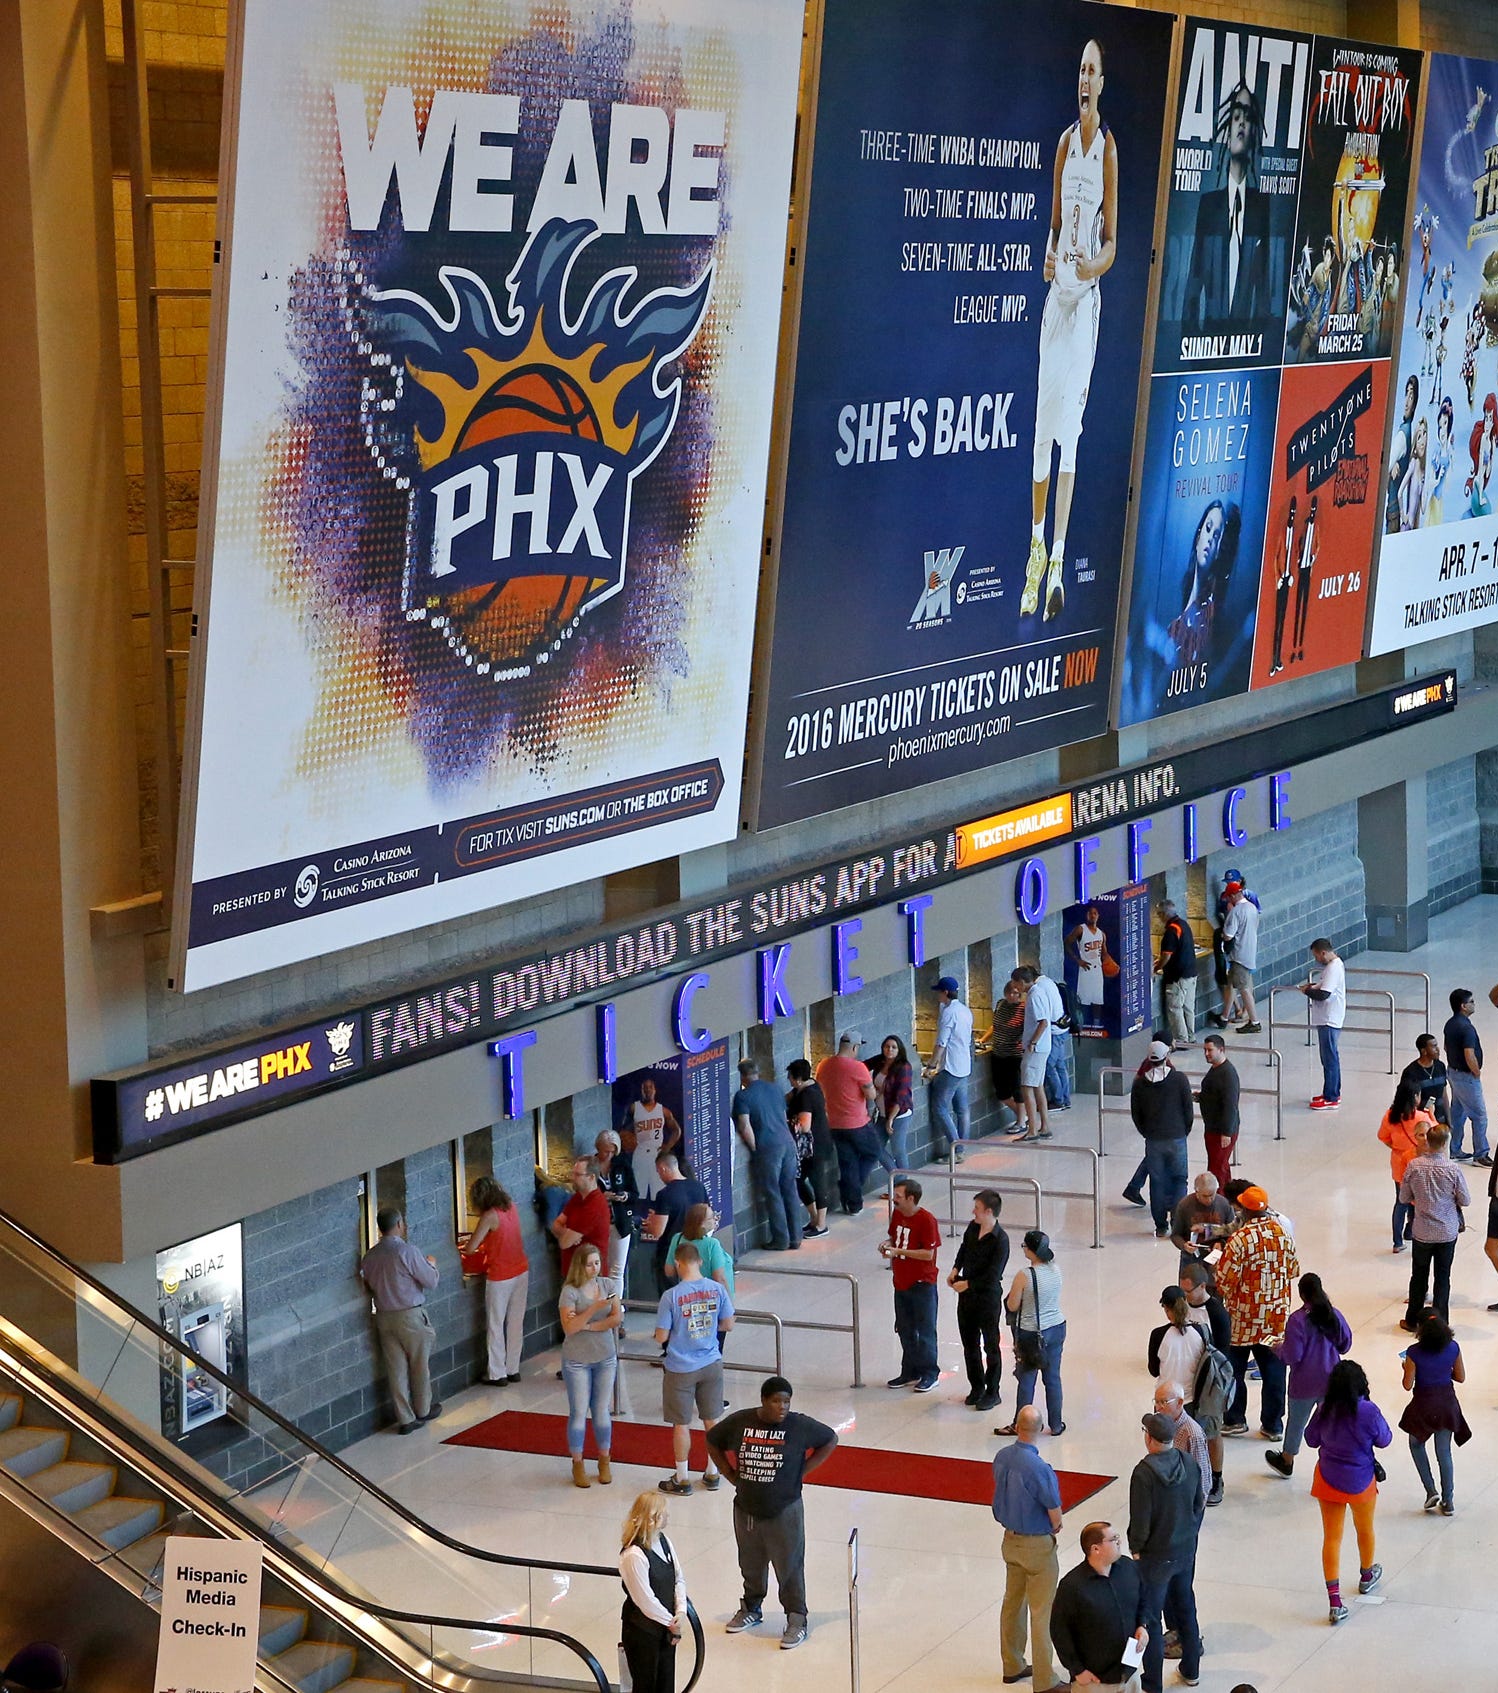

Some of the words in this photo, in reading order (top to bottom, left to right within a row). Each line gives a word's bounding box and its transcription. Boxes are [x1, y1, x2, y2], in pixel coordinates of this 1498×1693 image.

[1333, 49, 1365, 69] WINTOUR
[1366, 54, 1373, 68] IS
[1373, 54, 1399, 77] COMING
[1178, 27, 1309, 149] ANTI
[1318, 69, 1350, 126] FALL
[1354, 75, 1382, 127] OUT
[1381, 78, 1410, 132] BOY
[333, 82, 520, 232] WE
[526, 97, 725, 235] ARE
[860, 129, 936, 164] THREE-TIME
[940, 136, 975, 165] WNBA
[979, 139, 1042, 169] CHAMPION.
[1176, 148, 1212, 171] WORLD
[1175, 170, 1202, 191] TOUR
[1278, 176, 1296, 195] SCOTT
[904, 187, 963, 219] TWO-TIME
[967, 190, 1007, 220] FINALS
[1010, 192, 1037, 221] MVP.
[901, 242, 974, 272] SEVEN-TIME
[976, 244, 1033, 272] ALL-STAR.
[954, 295, 997, 324] LEAGUE
[1001, 295, 1028, 323] MVP.
[1327, 313, 1359, 332] FRIDAY
[1181, 335, 1226, 359] SUNDAY
[1230, 334, 1254, 356] MAY
[1257, 333, 1264, 355] 1
[1318, 335, 1352, 353] MARCH
[1352, 334, 1363, 352] 25
[1177, 380, 1251, 423] SELENA
[835, 397, 928, 467] SHE'S
[933, 392, 1018, 455] BACK.
[1173, 424, 1249, 468] GOMEZ
[1176, 474, 1211, 497] REVIVAL
[1215, 472, 1238, 493] TOUR
[430, 451, 615, 578] PHX
[1438, 543, 1467, 582] APR.
[1471, 541, 1480, 574] 7
[1319, 574, 1345, 600] JULY
[1347, 570, 1361, 592] 26
[1404, 596, 1441, 629] TALKING
[1442, 590, 1468, 619] STICK
[1166, 666, 1197, 698] JULY
[1199, 662, 1207, 690] 5
[784, 706, 833, 760] 2016
[837, 685, 926, 745] MERCURY
[930, 669, 995, 723] TICKETS
[999, 663, 1022, 704] ON
[1024, 655, 1061, 699] SALE
[1063, 647, 1099, 689] NOW
[887, 715, 1011, 768] phoenixmercury.com
[469, 834, 492, 854] FOR
[496, 826, 514, 847] TIX
[515, 819, 543, 842] VISIT
[544, 804, 606, 835] SUNS.COM
[607, 800, 622, 819] OR
[623, 794, 645, 815] THE
[647, 788, 669, 808] BOX
[671, 778, 708, 803] OFFICE
[972, 820, 1015, 850] TICKETS
[1015, 806, 1063, 837] AVAILABLE
[333, 855, 368, 873] CASINO
[371, 845, 412, 864] ARIZONA
[321, 882, 358, 902] TALKING
[360, 876, 385, 892] STICK
[387, 867, 420, 884] RESORT
[1097, 894, 1117, 902] NOW
[212, 890, 271, 915] PRESENTED
[274, 886, 287, 899] BY
[371, 980, 482, 1059] FANS!
[493, 921, 677, 1019] DOWNLOAD
[684, 899, 743, 955] THE
[750, 873, 827, 934] SUNS
[834, 856, 885, 908] APP
[892, 839, 938, 888] FOR
[1133, 764, 1180, 808] INFO.
[655, 1061, 679, 1071] NOW
[686, 1045, 726, 1069] SCHEDULE
[637, 1118, 663, 1133] SUNS
[654, 1129, 660, 1140] 2
[615, 1173, 623, 1184] 3
[744, 1427, 754, 1437] I'M
[755, 1428, 769, 1439] NOT
[769, 1430, 786, 1440] LAZY
[744, 1451, 761, 1459] VIDEO
[751, 1445, 774, 1453] EATING
[744, 1460, 774, 1468] WATCHING
[746, 1467, 776, 1476] SLEEPING
[177, 1566, 248, 1585] Hispanic
[186, 1589, 236, 1606] Media
[172, 1619, 246, 1637] Check-In
